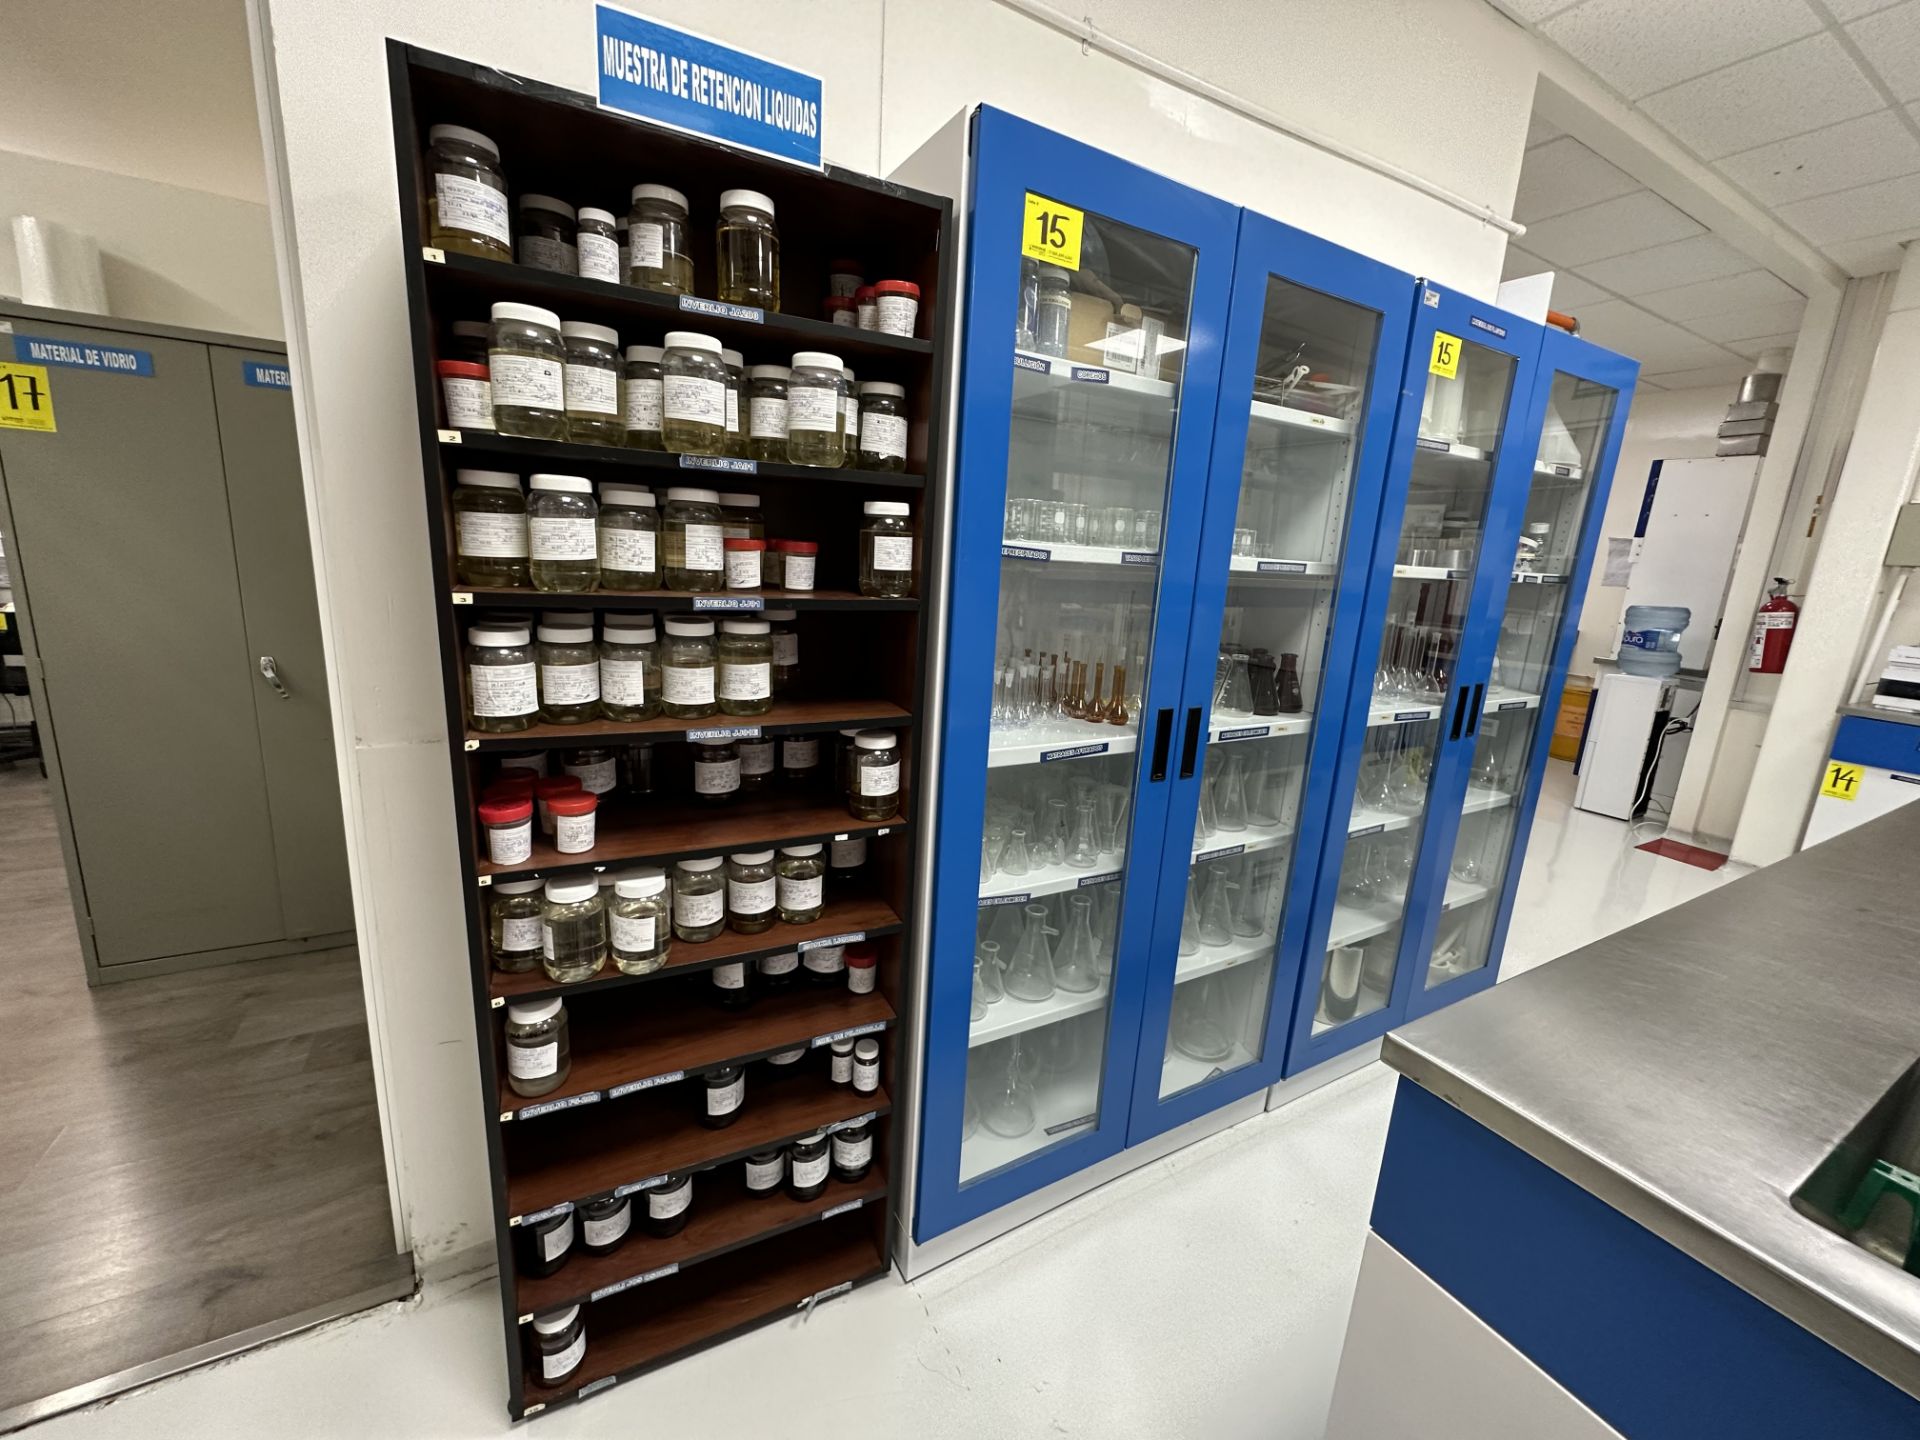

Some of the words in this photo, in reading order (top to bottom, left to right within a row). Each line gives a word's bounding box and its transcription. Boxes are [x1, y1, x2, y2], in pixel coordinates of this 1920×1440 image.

[603, 34, 669, 93] MUESTRA
[671, 56, 689, 99] DE
[691, 63, 762, 122] RETENCION
[764, 87, 817, 139] LIQUIDAS
[1036, 211, 1070, 248] 15
[30, 342, 84, 365] MATERIAL
[84, 349, 100, 367] DE
[102, 351, 137, 371] VIDRIO
[1437, 341, 1454, 366] 15
[0, 373, 46, 411] 17
[1831, 767, 1858, 791] 14
